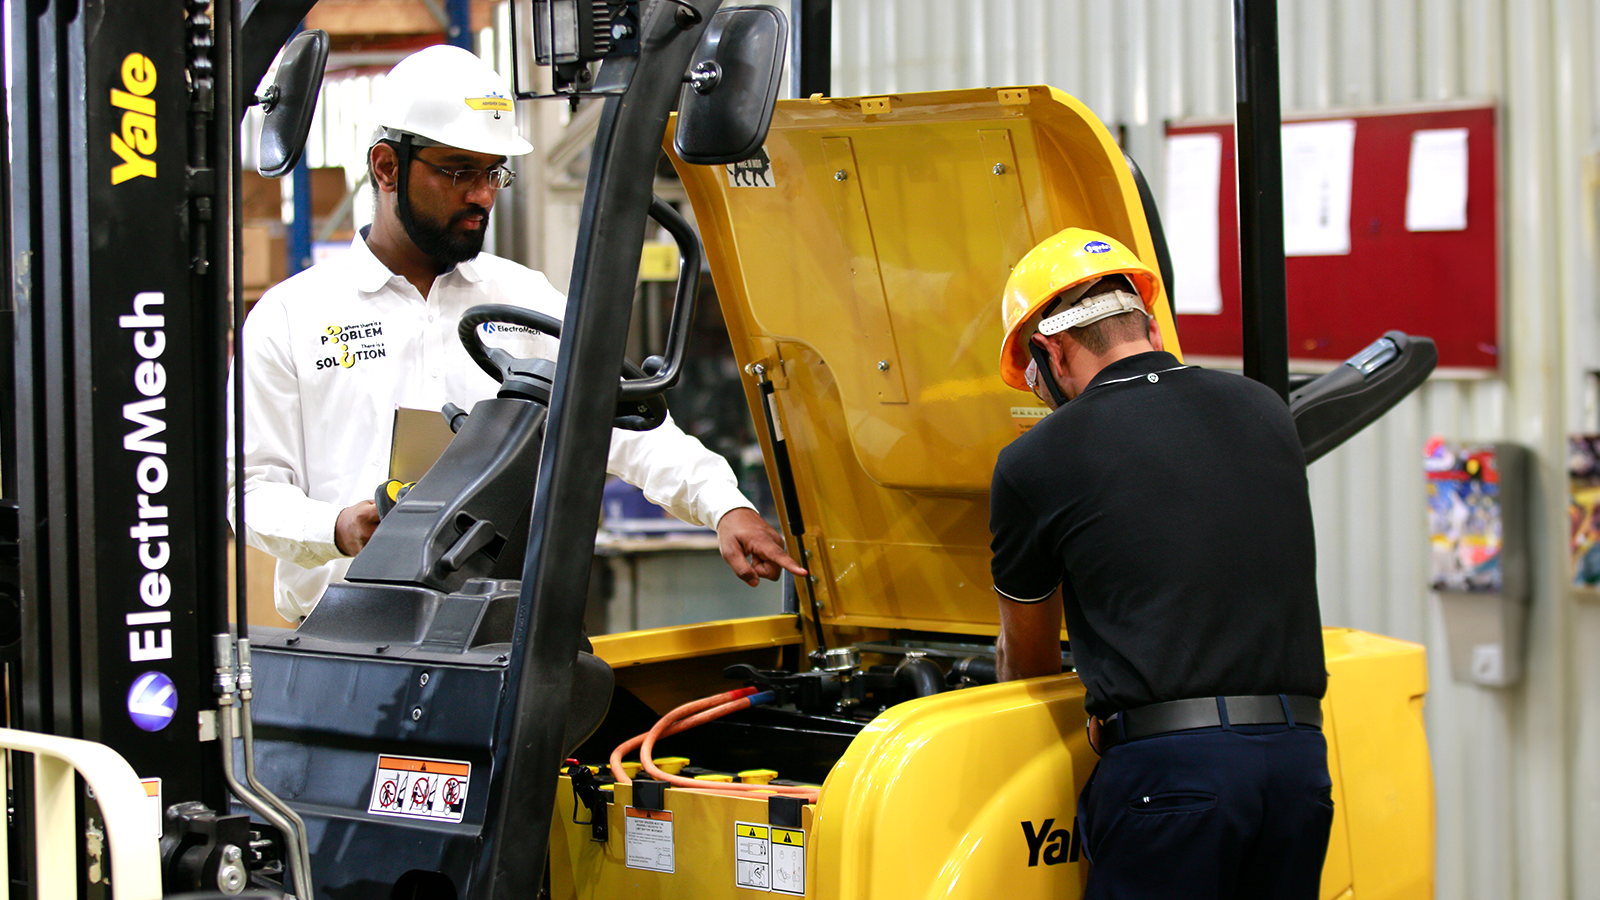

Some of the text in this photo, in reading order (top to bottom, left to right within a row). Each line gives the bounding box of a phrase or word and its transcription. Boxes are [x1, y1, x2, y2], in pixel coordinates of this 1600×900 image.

[110, 52, 157, 185] Yale
[118, 291, 173, 663] ElectroMech
[1020, 816, 1081, 867] Yal
